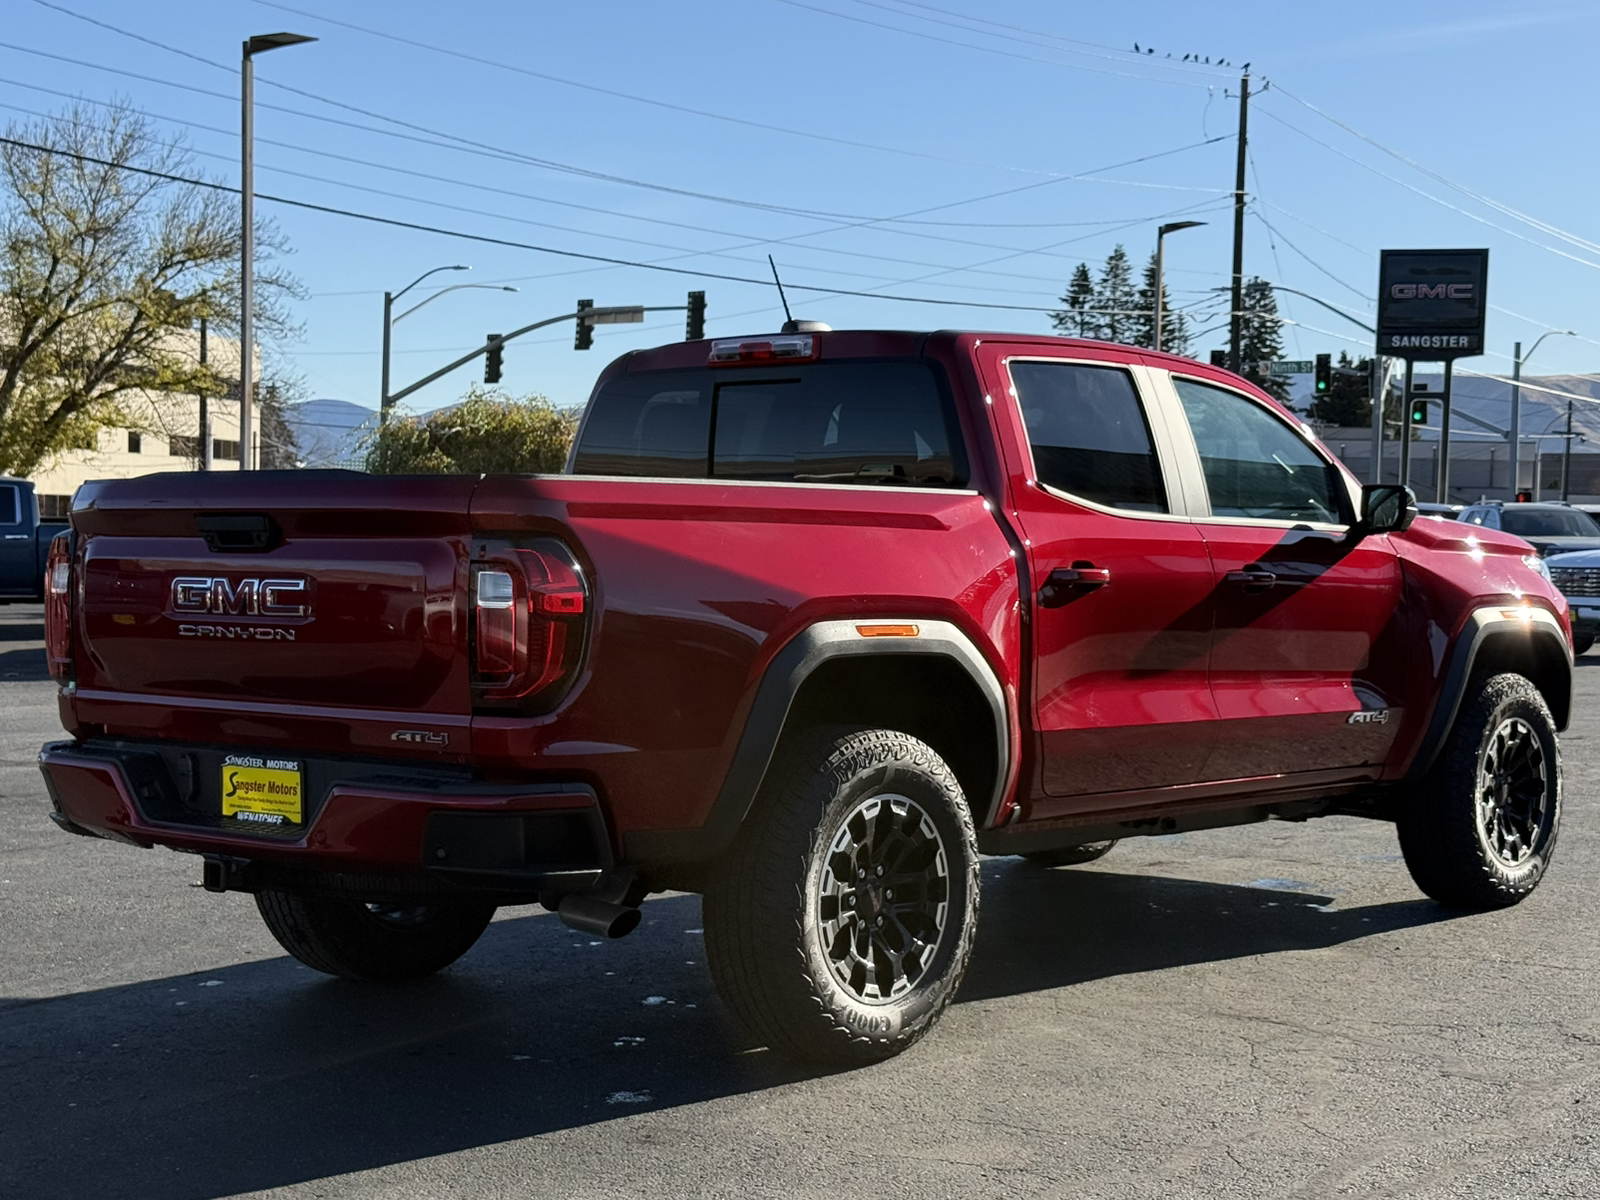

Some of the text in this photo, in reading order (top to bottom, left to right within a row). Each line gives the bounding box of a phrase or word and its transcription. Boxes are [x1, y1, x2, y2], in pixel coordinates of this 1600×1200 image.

[1391, 284, 1473, 299] GMC
[1391, 335, 1469, 348] SANGSTER
[1271, 362, 1312, 373] Ninth St
[171, 577, 311, 616] GMC
[178, 624, 296, 641] CANYON
[1348, 710, 1389, 725] AT4
[391, 730, 449, 748] AT4
[220, 754, 298, 771] SANGSTER MOTORS
[225, 771, 298, 797] Sangster Motors
[236, 811, 283, 824] WENATCHEE
